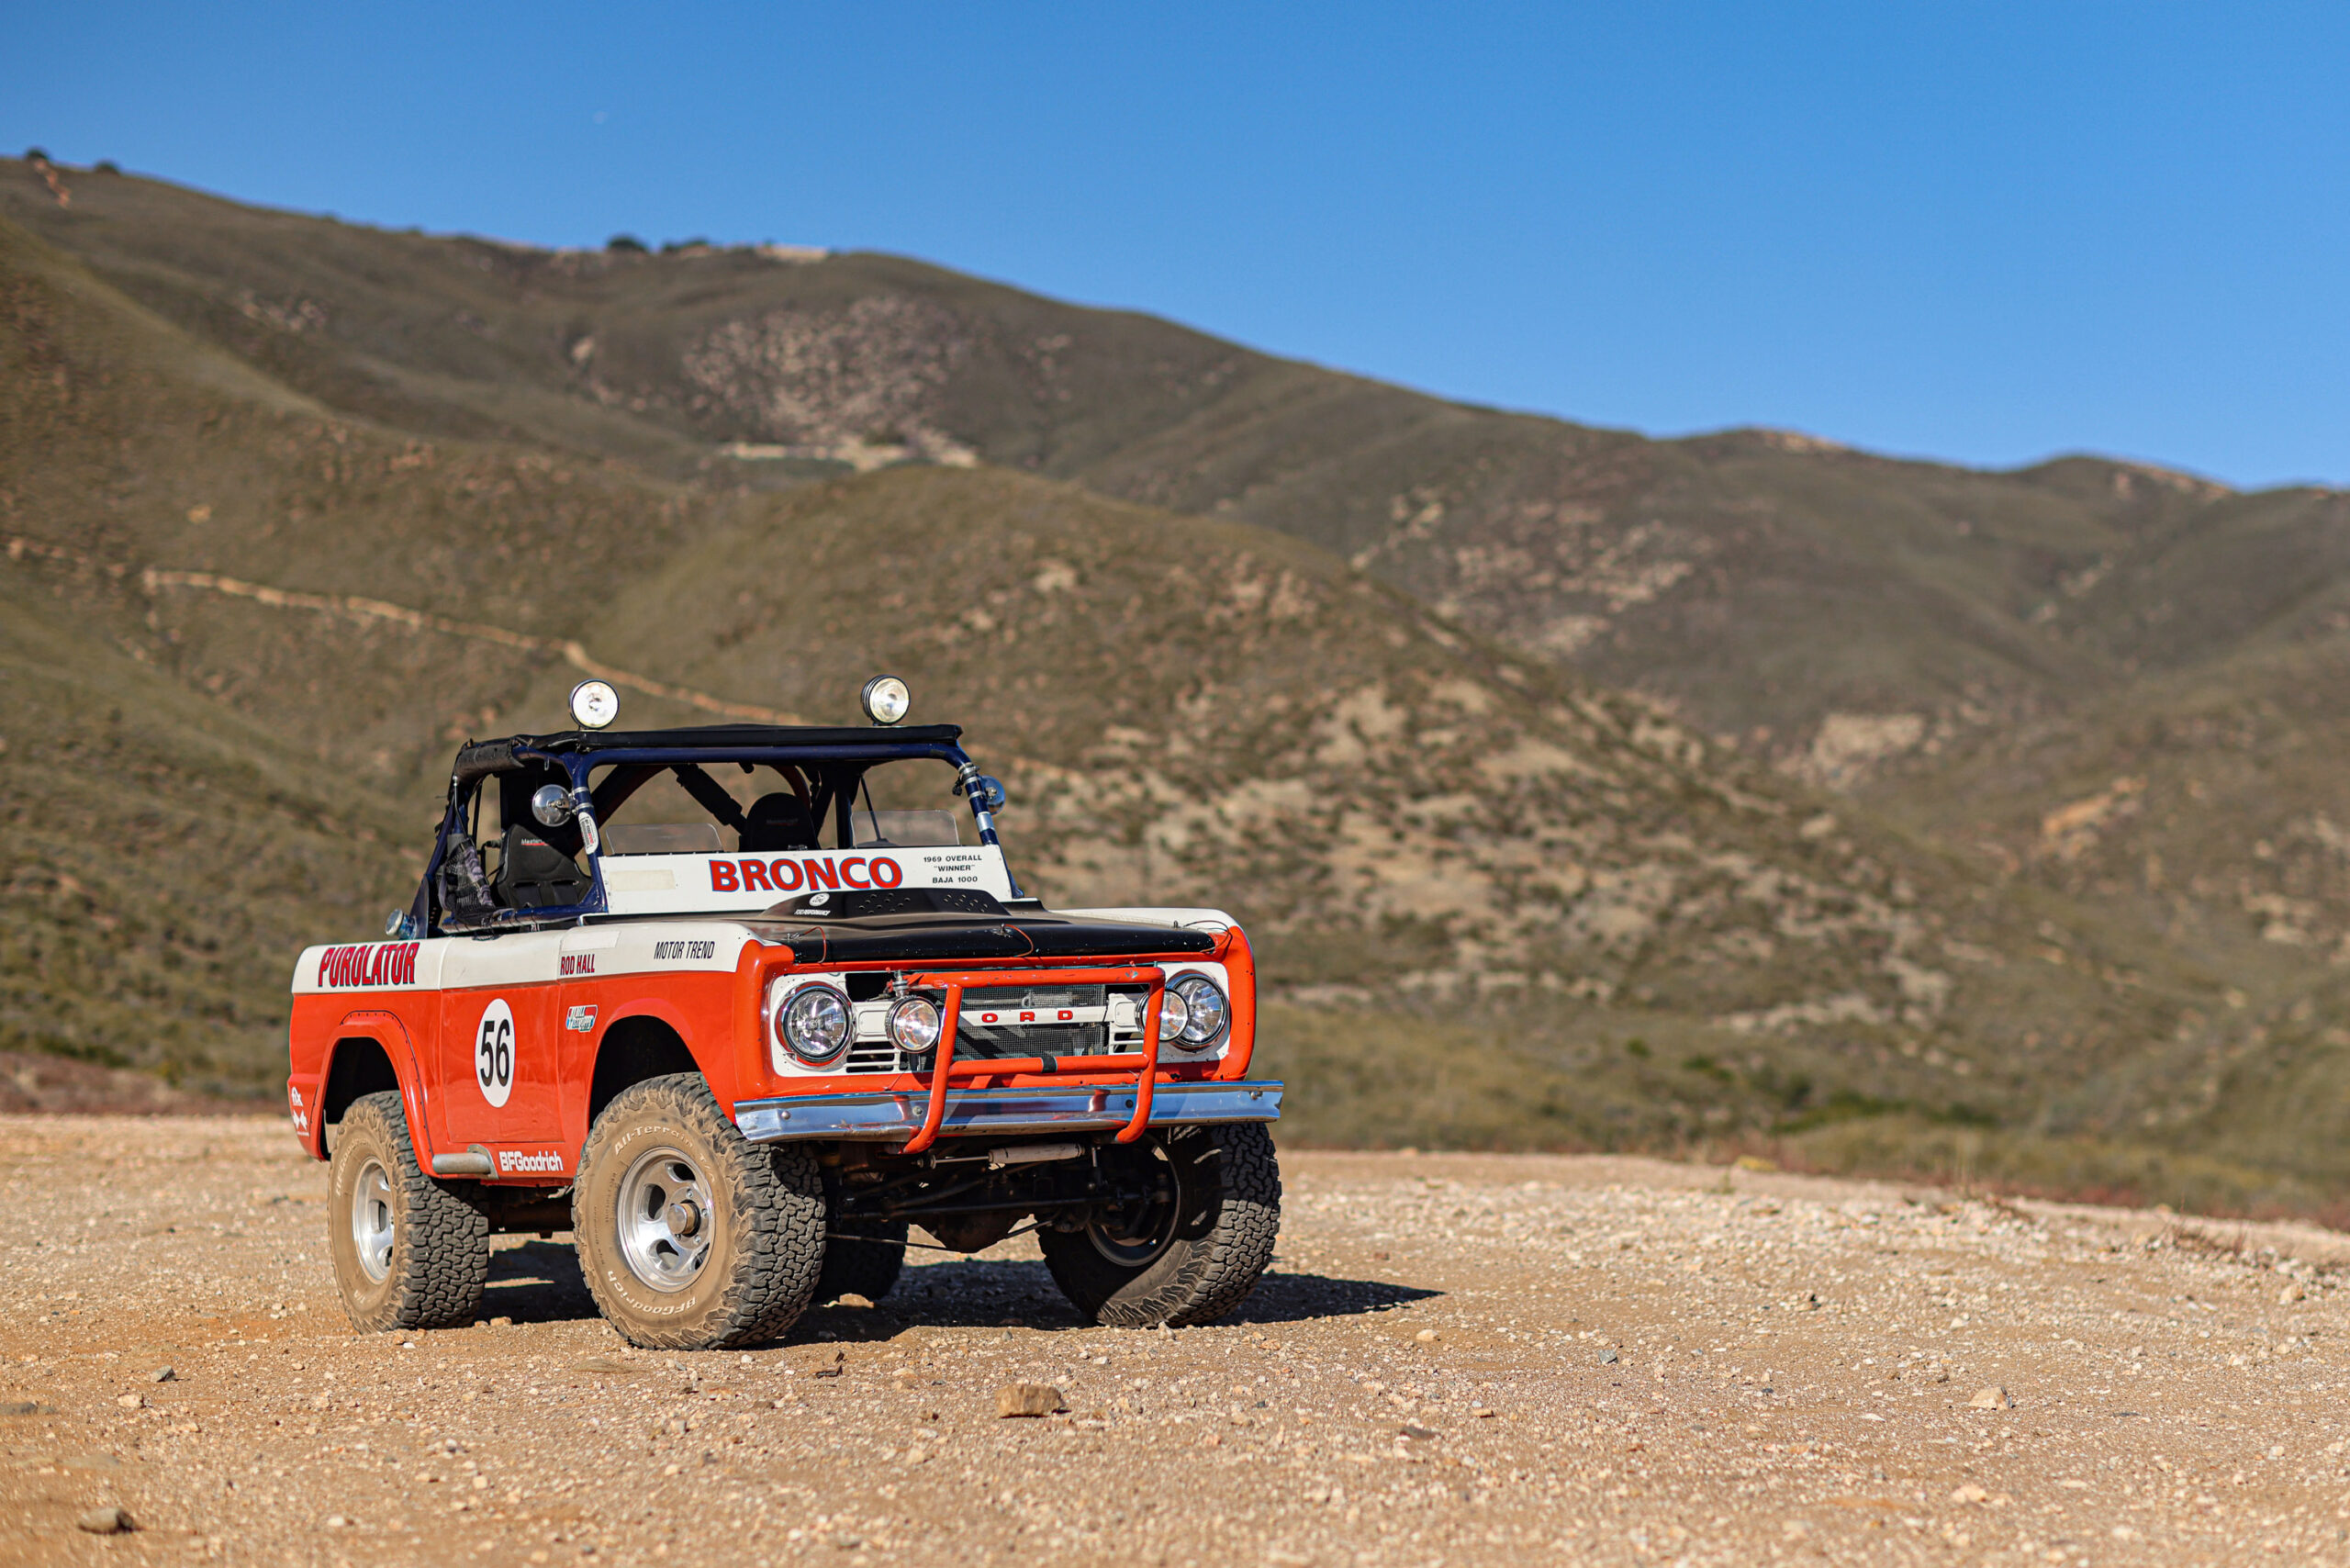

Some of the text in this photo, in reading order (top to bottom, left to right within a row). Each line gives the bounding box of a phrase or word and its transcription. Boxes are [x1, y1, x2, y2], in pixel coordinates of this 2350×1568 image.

[946, 854, 982, 862] OVERALL
[708, 857, 903, 892] BRONCO
[932, 876, 954, 884] BAJA
[654, 940, 715, 959] MOTOR TREND
[318, 942, 420, 988] PUROLATOR
[560, 953, 595, 976] ROD HALL
[980, 1010, 1074, 1024] ORD
[480, 1018, 510, 1087] 56
[614, 1125, 694, 1157] All-Terrain
[498, 1150, 564, 1172] BFGoodrich
[607, 1270, 696, 1316] BFGoodrich
